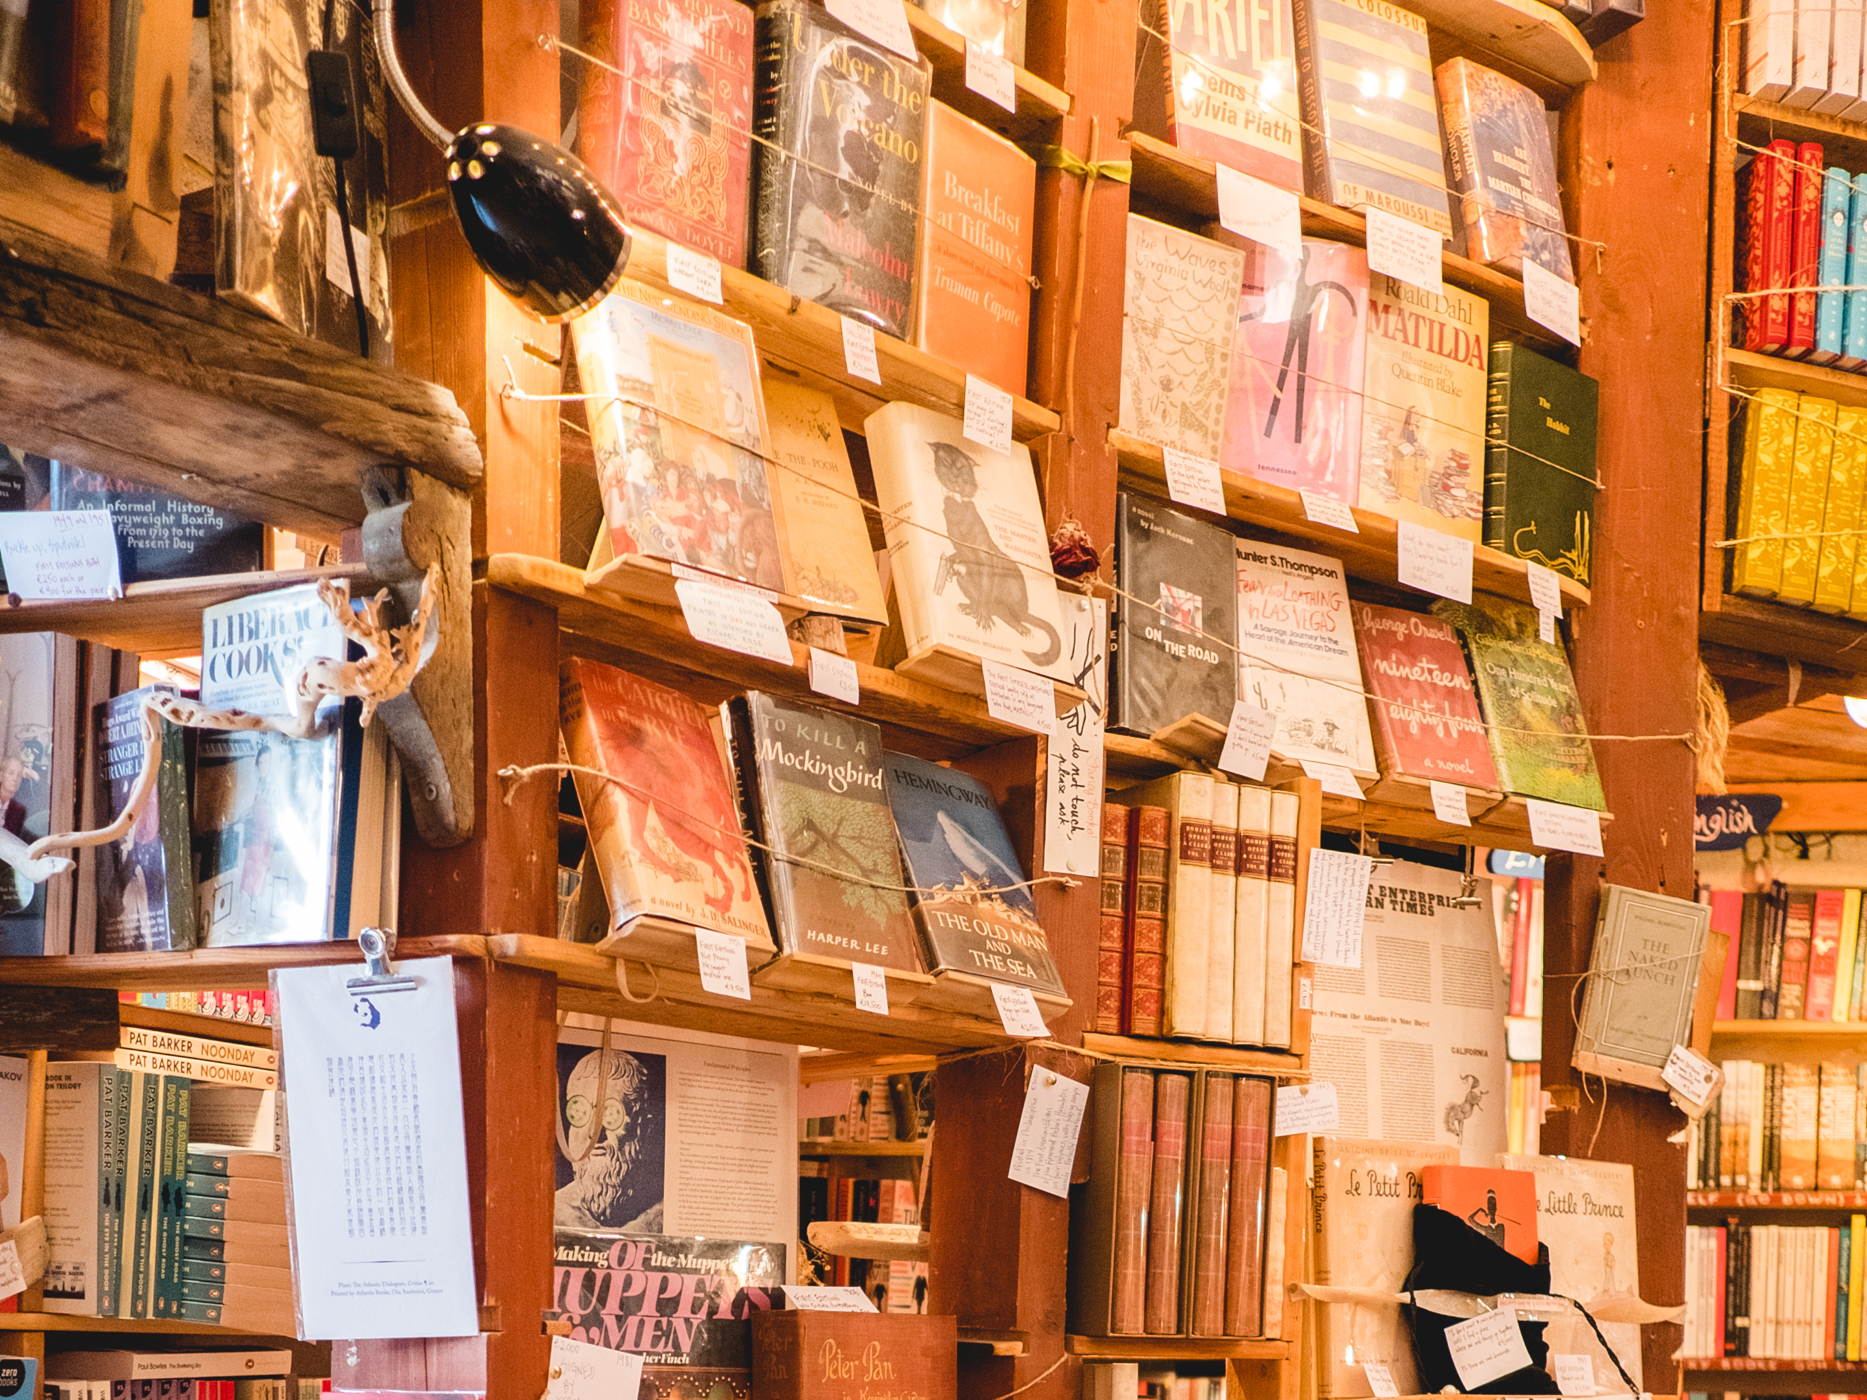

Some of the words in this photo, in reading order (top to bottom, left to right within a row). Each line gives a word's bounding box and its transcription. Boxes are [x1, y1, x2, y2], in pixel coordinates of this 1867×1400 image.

[819, 78, 918, 164] Volcano
[1244, 109, 1293, 146] Plath
[944, 171, 1020, 235] Breakfast
[1364, 189, 1429, 222] MAROUSSI
[936, 206, 956, 227] at
[959, 206, 1023, 271] Tiffany's
[1164, 231, 1228, 276] Waves
[934, 266, 980, 305] Truman
[983, 290, 1021, 327] Capote
[1385, 275, 1431, 309] Roald
[1434, 293, 1472, 325] Dahl
[1367, 300, 1485, 371] MATILDA
[1391, 364, 1426, 389] Quentin
[1429, 375, 1463, 399] Blake
[1546, 416, 1570, 435] Hobbit
[811, 459, 838, 472] POOH
[102, 500, 156, 512] Informal
[167, 501, 214, 517] History
[181, 514, 223, 529] Boxing
[118, 526, 146, 537] from
[185, 526, 205, 537] the
[128, 537, 169, 549] Present
[173, 537, 194, 553] Day
[1004, 540, 1042, 559] MARGARITA
[37, 573, 57, 584] €250
[208, 635, 304, 684] COOKS
[1145, 627, 1162, 642] ON
[1164, 638, 1186, 655] THE
[1187, 644, 1219, 665] ROAD
[1374, 656, 1472, 690] nineteen
[1522, 686, 1558, 707] Solitude
[762, 713, 786, 733] TO
[796, 721, 845, 749] KILL
[855, 740, 867, 755] A
[1390, 702, 1485, 739] eighty-four
[759, 738, 883, 792] Mockingbird
[1071, 736, 1089, 765] do
[1052, 752, 1075, 795] please
[1069, 767, 1082, 795] not
[1438, 758, 1475, 774] novel
[893, 768, 991, 810] HEMINGWAY
[1056, 803, 1067, 829] ask.
[1064, 798, 1079, 841] touch,
[1695, 800, 1757, 842] nglish
[1389, 899, 1435, 917] TIMES
[720, 912, 767, 937] SALINGER
[932, 910, 970, 931] THE
[974, 918, 1006, 942] OLD
[1008, 929, 1047, 951] MAN
[807, 929, 854, 951] HARPER
[861, 941, 889, 956] LEE
[986, 939, 1012, 955] AND
[1641, 938, 1670, 954] THE
[969, 948, 1003, 972] THE
[1005, 955, 1037, 979] SEA
[1629, 950, 1678, 972] NAKED
[129, 1031, 149, 1047] PAT
[152, 1033, 193, 1054] BARKER
[201, 1042, 255, 1063] NOONDAY
[1451, 1046, 1488, 1057] CALIFORNIA
[105, 1077, 113, 1107] PAT
[1368, 1168, 1400, 1198] Petit
[1544, 1191, 1578, 1216] Little
[1583, 1192, 1624, 1219] Prince
[608, 1240, 654, 1270] OF
[150, 1362, 167, 1370] Bowles
[560, 1360, 595, 1380] SIGNED
[616, 1352, 633, 1368] 1981
[663, 1354, 689, 1364] Finch
[819, 1340, 859, 1382] Peter
[862, 1342, 896, 1382] Pan.
[563, 1379, 574, 1392] BY
